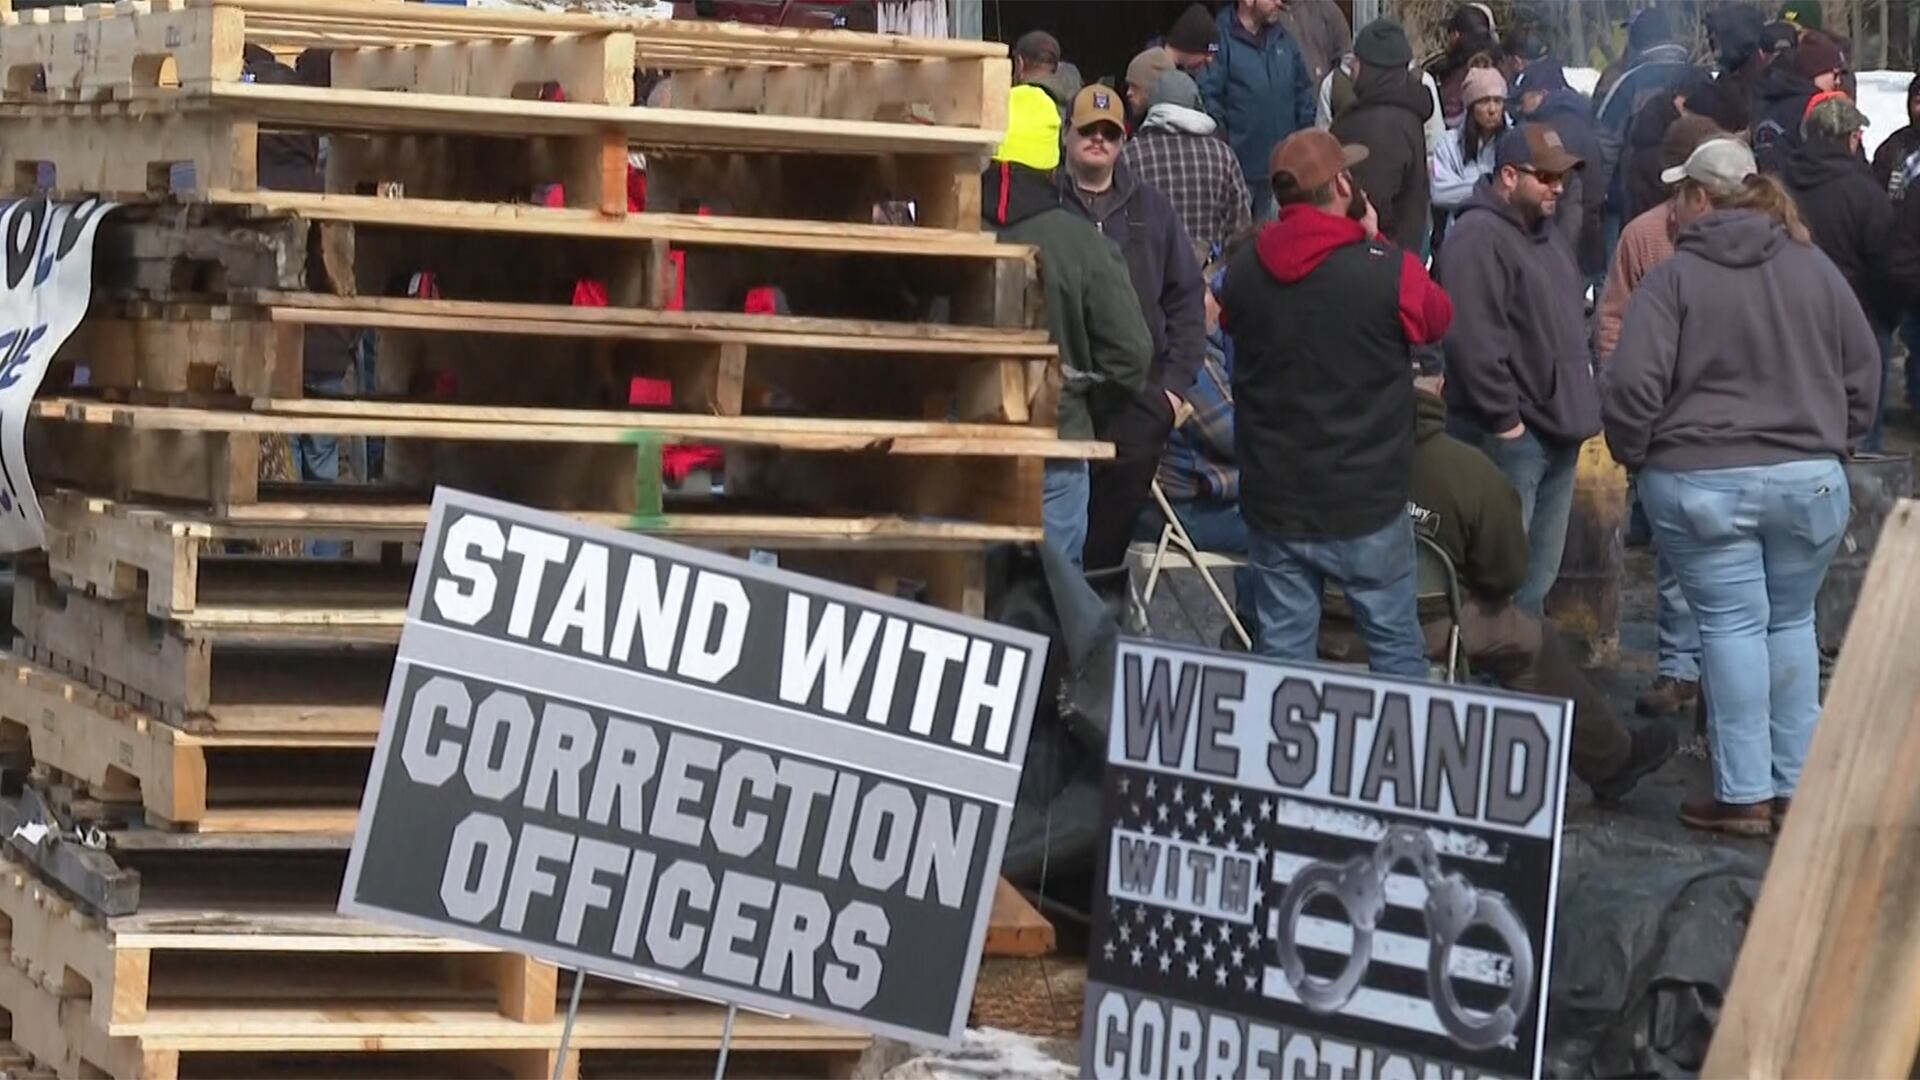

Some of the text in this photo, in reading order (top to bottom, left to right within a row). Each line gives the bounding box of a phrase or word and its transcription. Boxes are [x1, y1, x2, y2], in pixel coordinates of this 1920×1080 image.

[433, 513, 1027, 754] STAND WITH
[400, 676, 982, 910] CORRECTION
[1122, 653, 1551, 828] WE STAND
[439, 811, 891, 1011] OFFICERS
[1118, 836, 1252, 915] WITH
[1092, 989, 1509, 1080] CORREC
